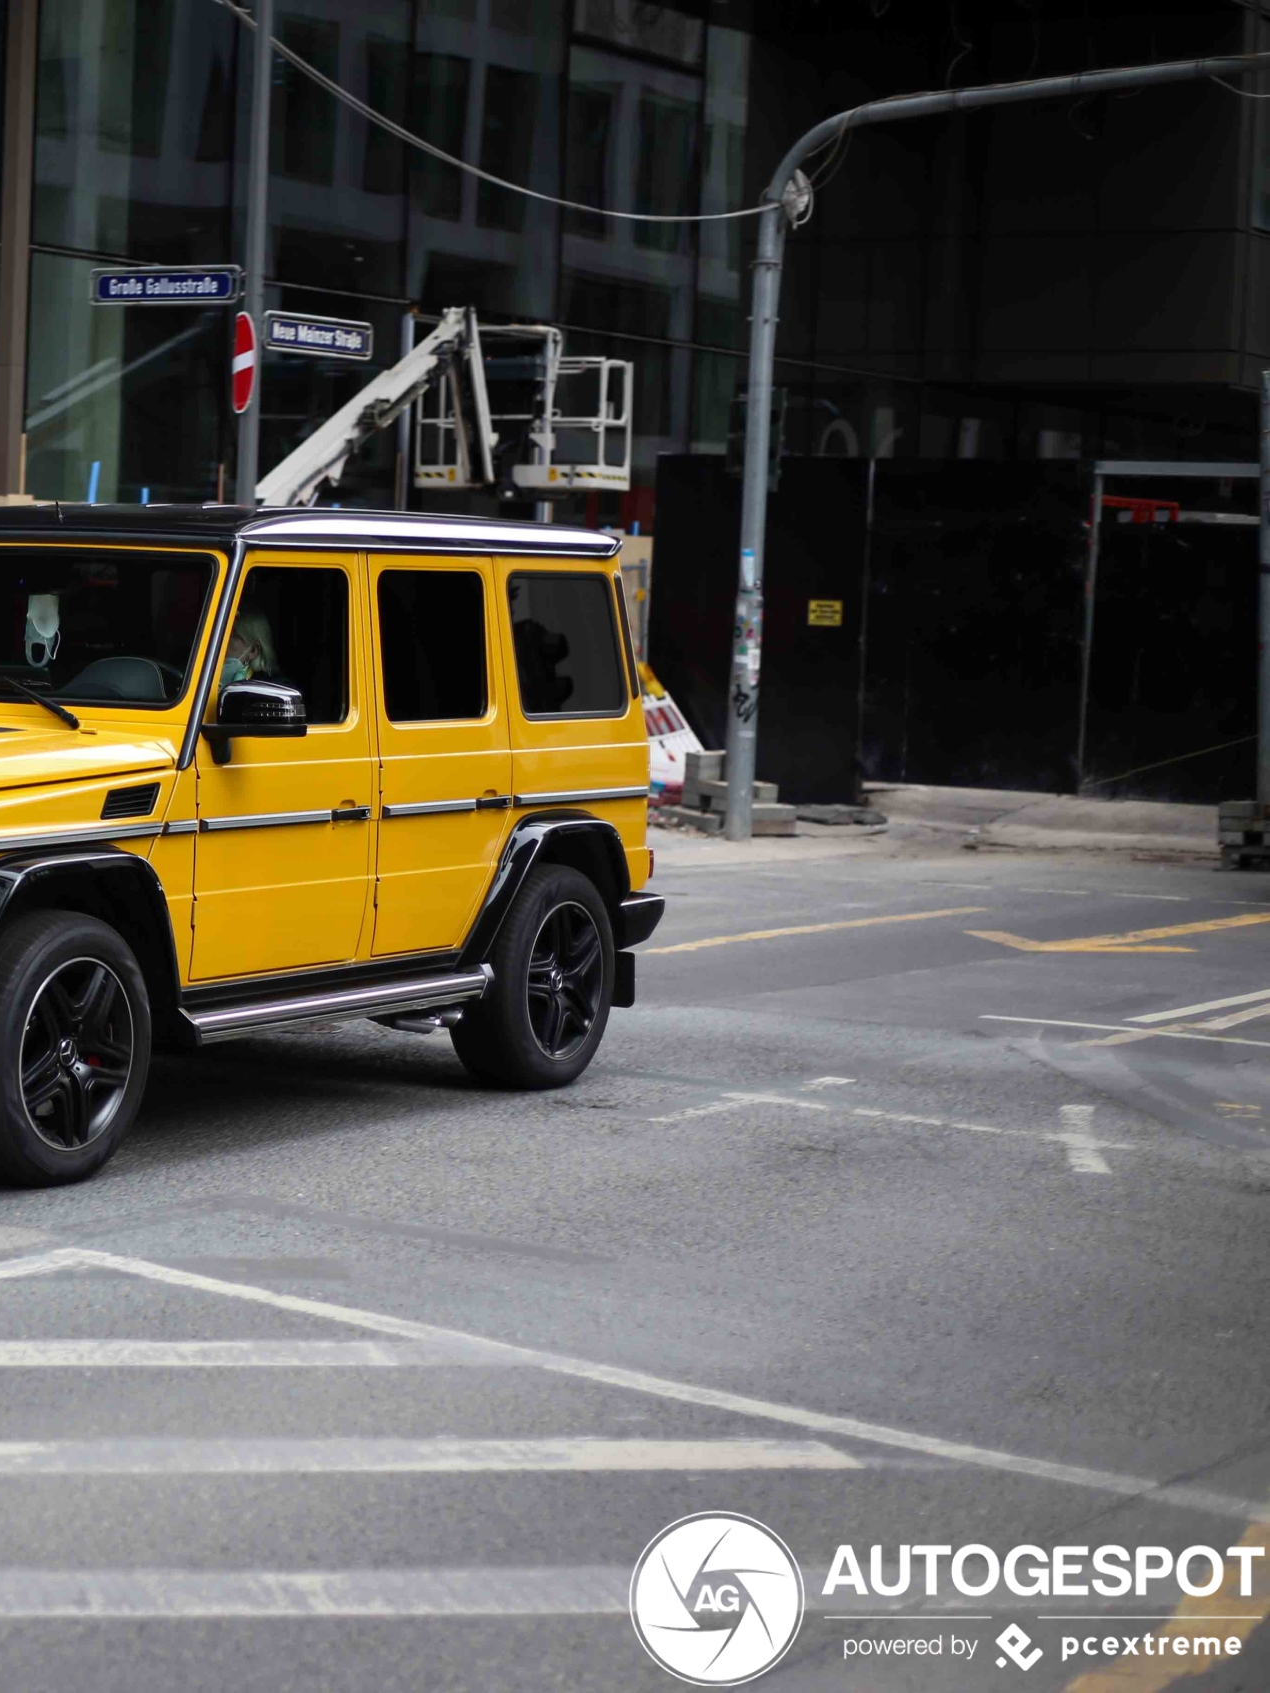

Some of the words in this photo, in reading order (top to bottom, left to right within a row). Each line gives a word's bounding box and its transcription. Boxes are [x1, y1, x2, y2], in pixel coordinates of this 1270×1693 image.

[109, 278, 143, 295] Große
[145, 276, 219, 294] Gallusstraße
[272, 321, 297, 341] Neue
[297, 324, 335, 346] Mainzer
[334, 329, 363, 350] Straße
